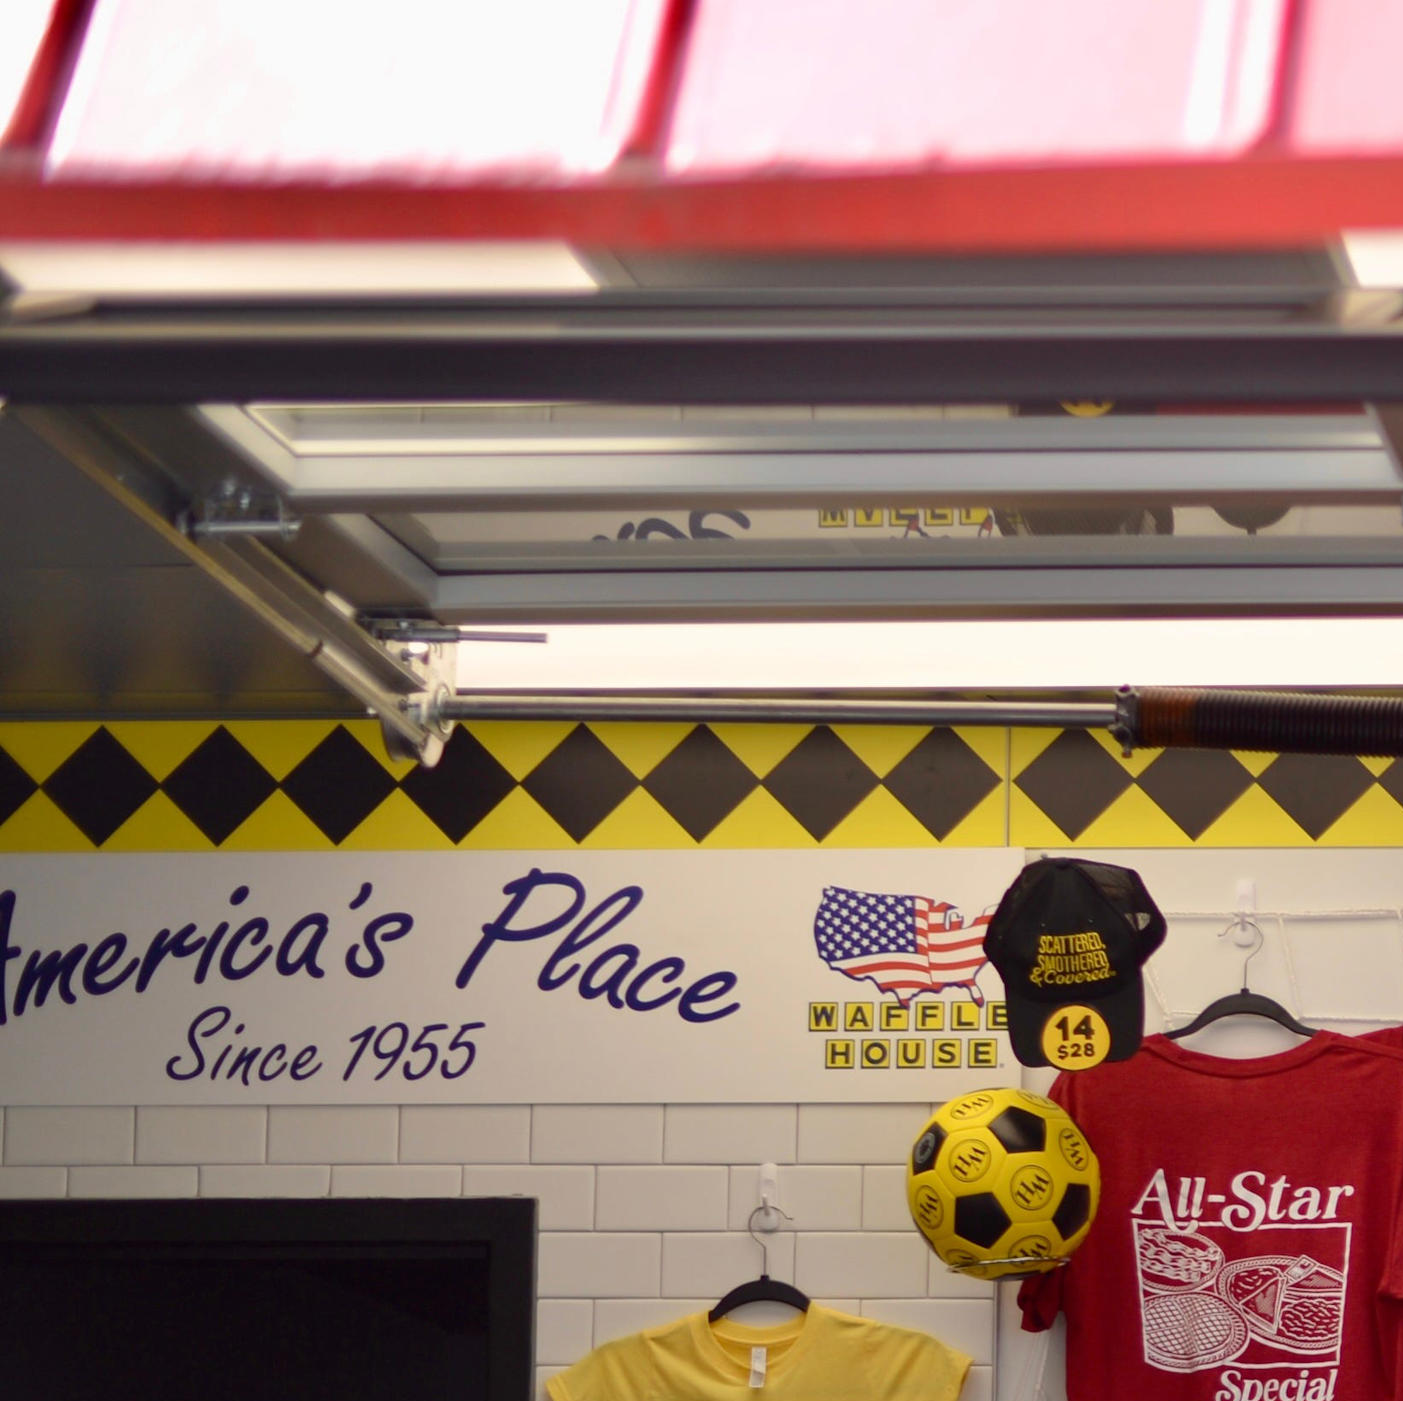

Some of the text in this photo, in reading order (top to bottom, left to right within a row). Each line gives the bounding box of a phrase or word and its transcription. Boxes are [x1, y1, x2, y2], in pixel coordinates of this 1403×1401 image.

[455, 868, 741, 1022] Place
[811, 1004, 1008, 1028] WAFFLE
[1056, 1015, 1095, 1041] 14
[166, 1006, 485, 1085] Since 1955
[829, 1041, 995, 1065] HOUSE
[1057, 1043, 1095, 1060] $28
[1131, 1168, 1354, 1232] All-Star
